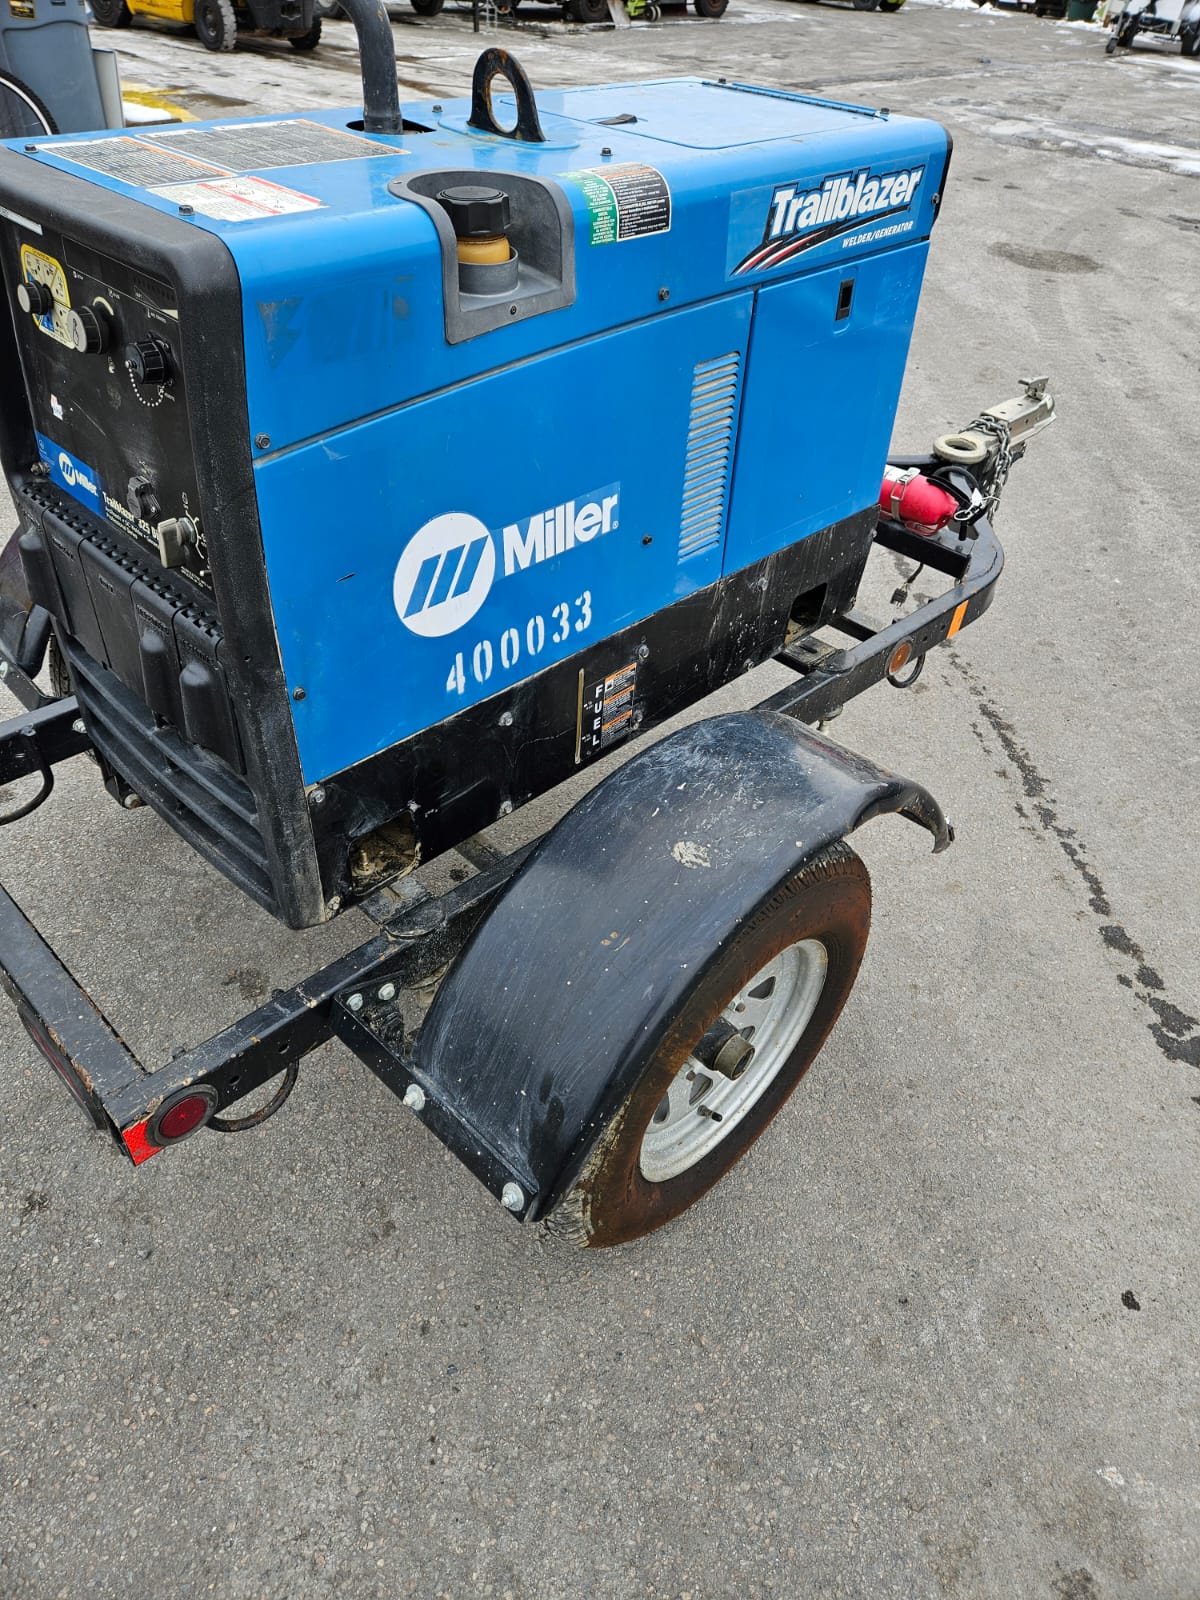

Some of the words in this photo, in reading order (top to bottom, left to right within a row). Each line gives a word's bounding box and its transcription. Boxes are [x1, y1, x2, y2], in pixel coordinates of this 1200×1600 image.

[769, 167, 924, 238] Trailblazer
[842, 220, 914, 249] WELDER/GENERATOR
[75, 469, 98, 496] Miller
[503, 493, 618, 577] Miller
[446, 590, 592, 695] 400033
[592, 683, 604, 746] FUEL
